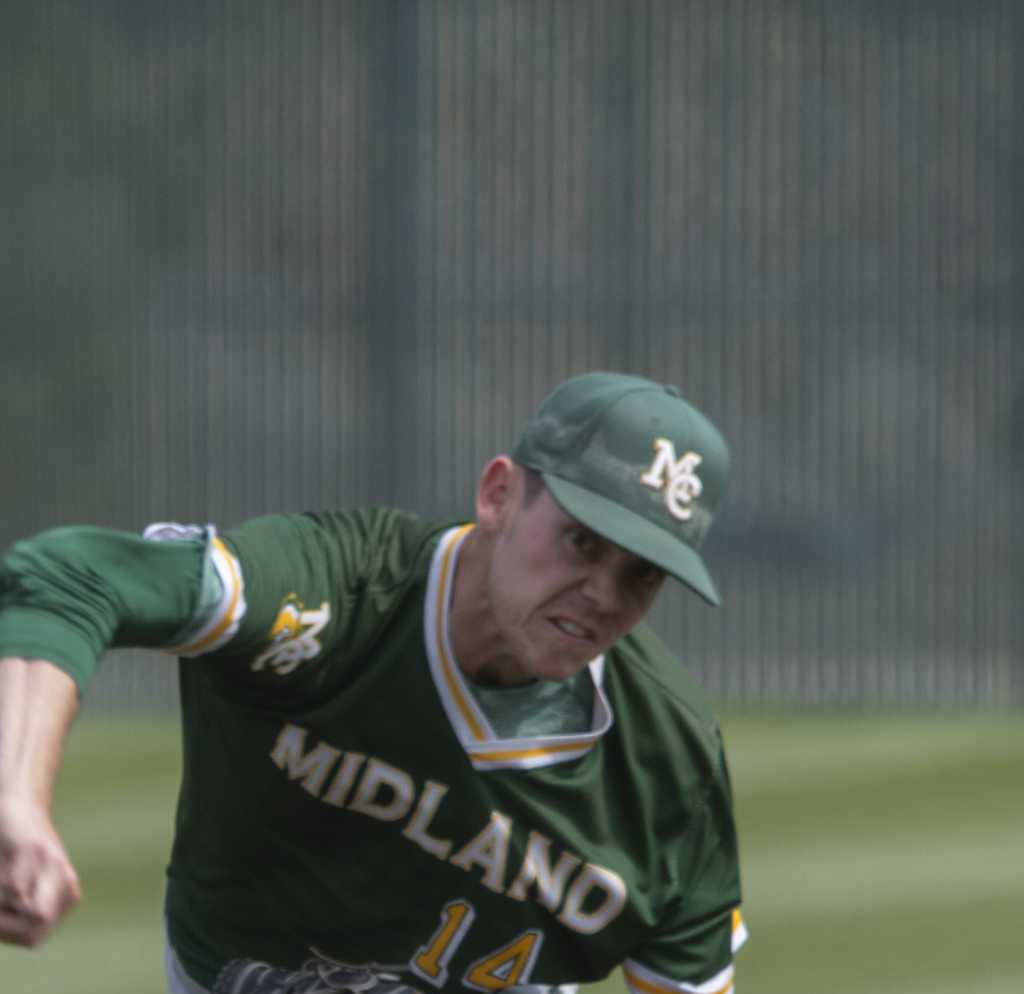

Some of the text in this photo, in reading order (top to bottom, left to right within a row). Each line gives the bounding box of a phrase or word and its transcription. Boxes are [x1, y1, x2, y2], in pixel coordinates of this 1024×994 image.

[640, 437, 703, 520] MC
[270, 723, 628, 935] MIDLAND
[409, 899, 543, 992] 14
